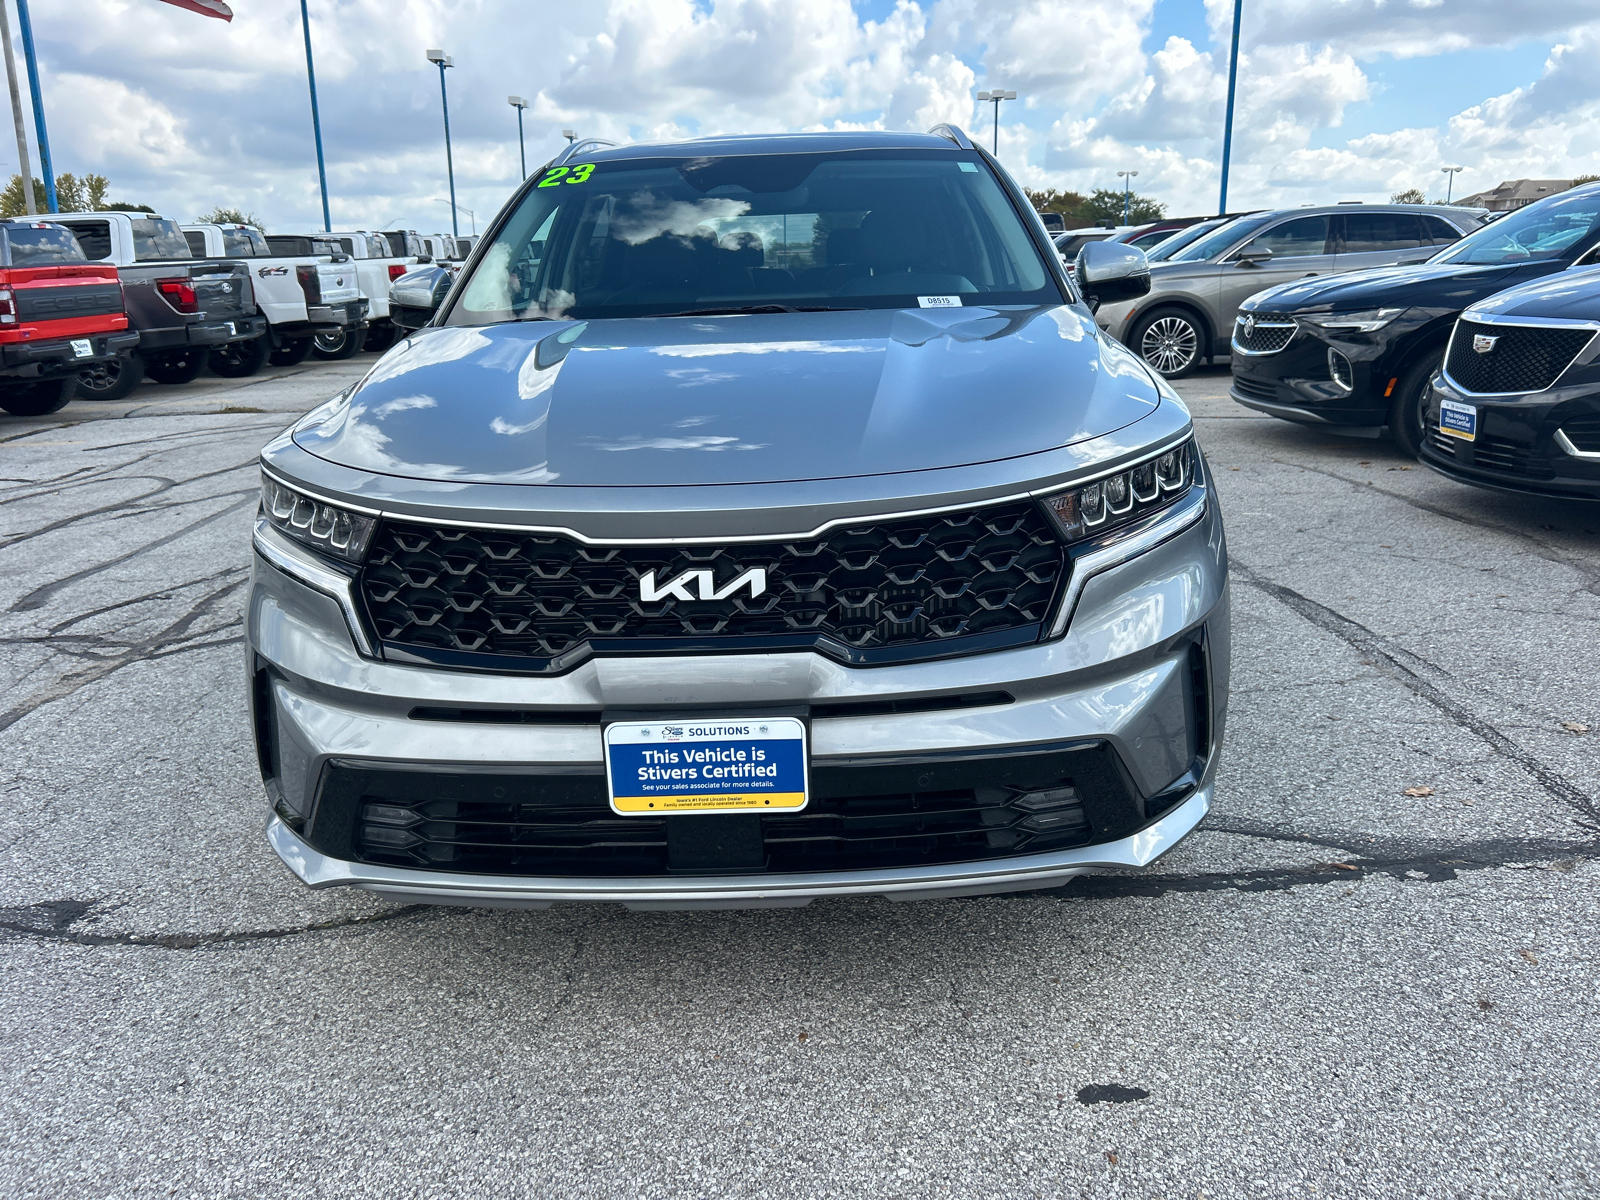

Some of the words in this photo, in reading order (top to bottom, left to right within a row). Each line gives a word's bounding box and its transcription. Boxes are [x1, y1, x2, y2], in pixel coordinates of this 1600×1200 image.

[537, 163, 596, 188] 23
[32, 294, 111, 312] FORD
[1456, 419, 1470, 428] Certified
[640, 567, 767, 601] KIA
[688, 726, 750, 737] SOLUTIONS
[642, 749, 679, 764] This
[683, 747, 747, 763] Vehicle
[751, 746, 766, 761] is
[638, 766, 698, 780] Stivers
[702, 763, 778, 778] Certified
